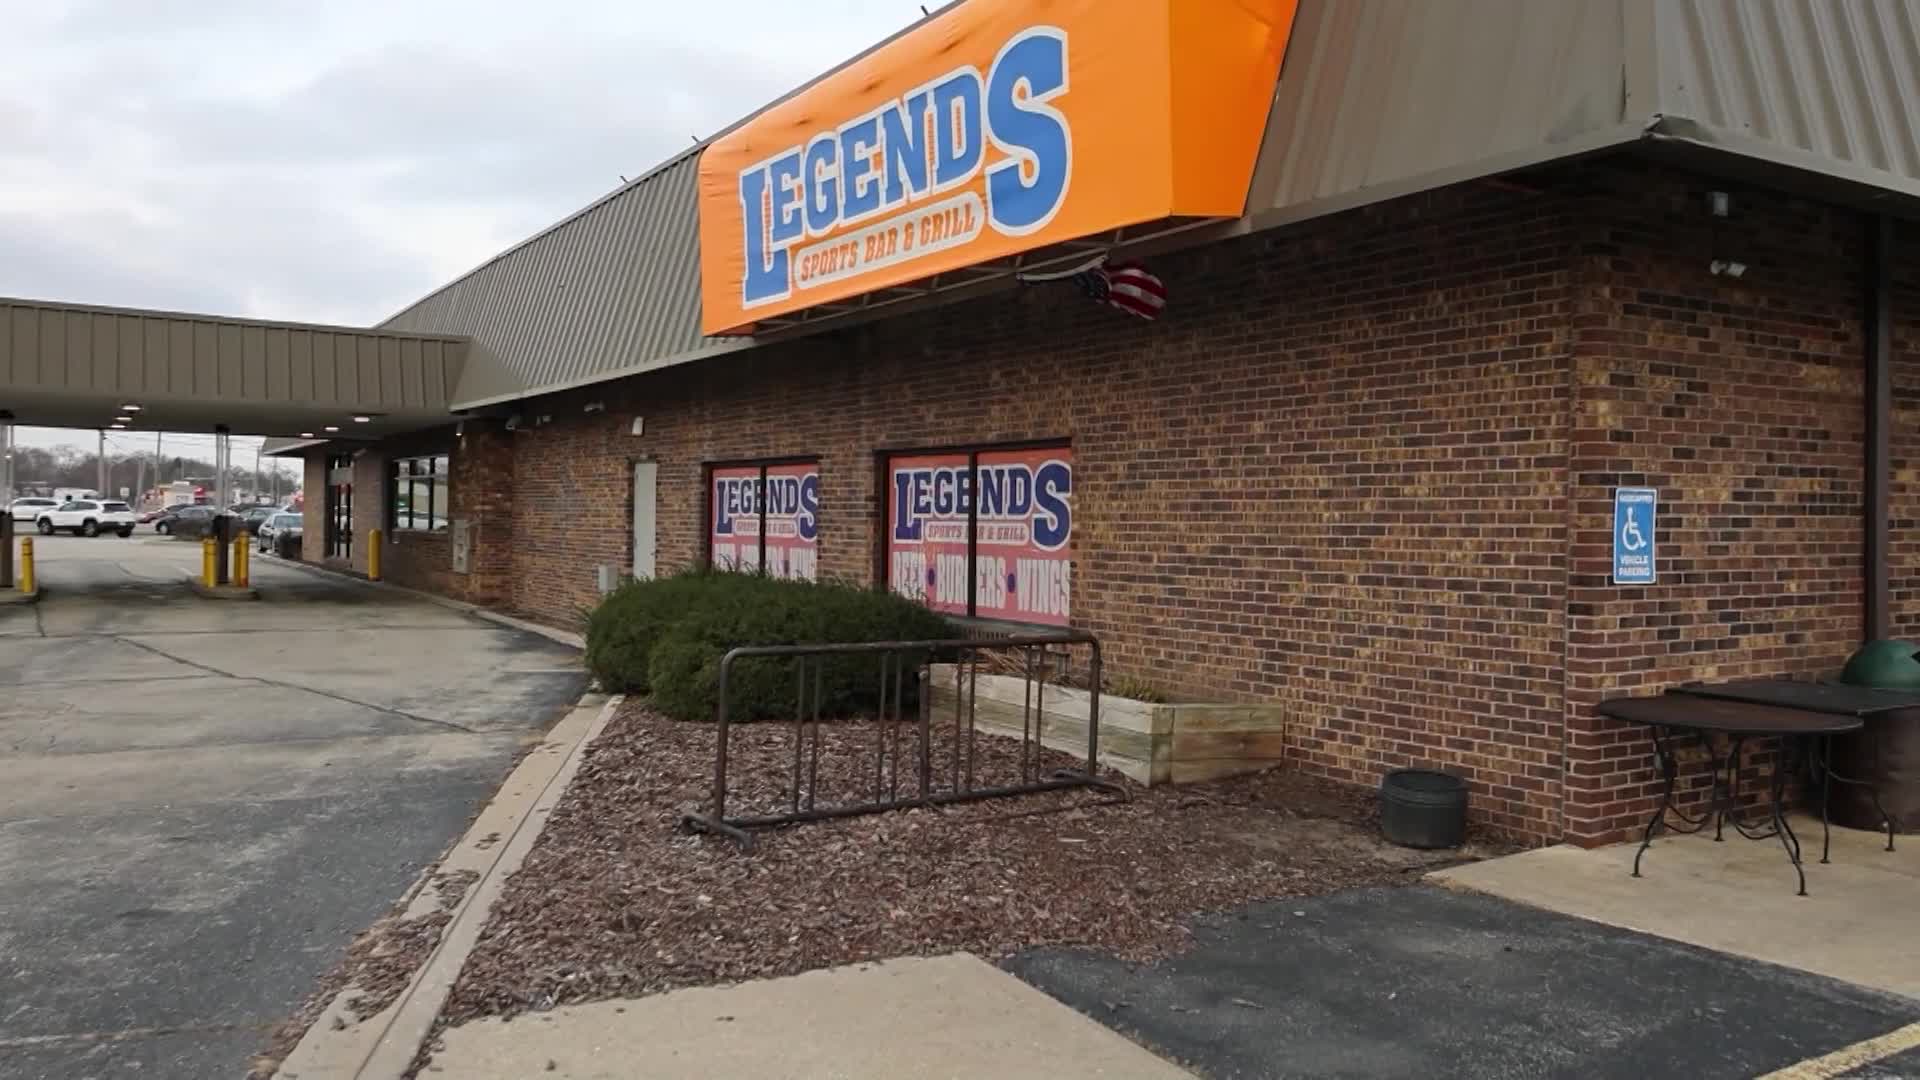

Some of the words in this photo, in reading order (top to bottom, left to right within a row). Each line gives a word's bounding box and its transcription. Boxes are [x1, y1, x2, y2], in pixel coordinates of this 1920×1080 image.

[741, 26, 1071, 309] LEGENDS
[801, 241, 859, 281] SPORTS
[864, 227, 898, 263] BAR
[903, 211, 914, 250] &
[920, 202, 976, 246] GRILL
[894, 460, 1071, 550] LEGENDS
[936, 553, 1006, 609] BURERS
[1016, 558, 1071, 616] WINGS
